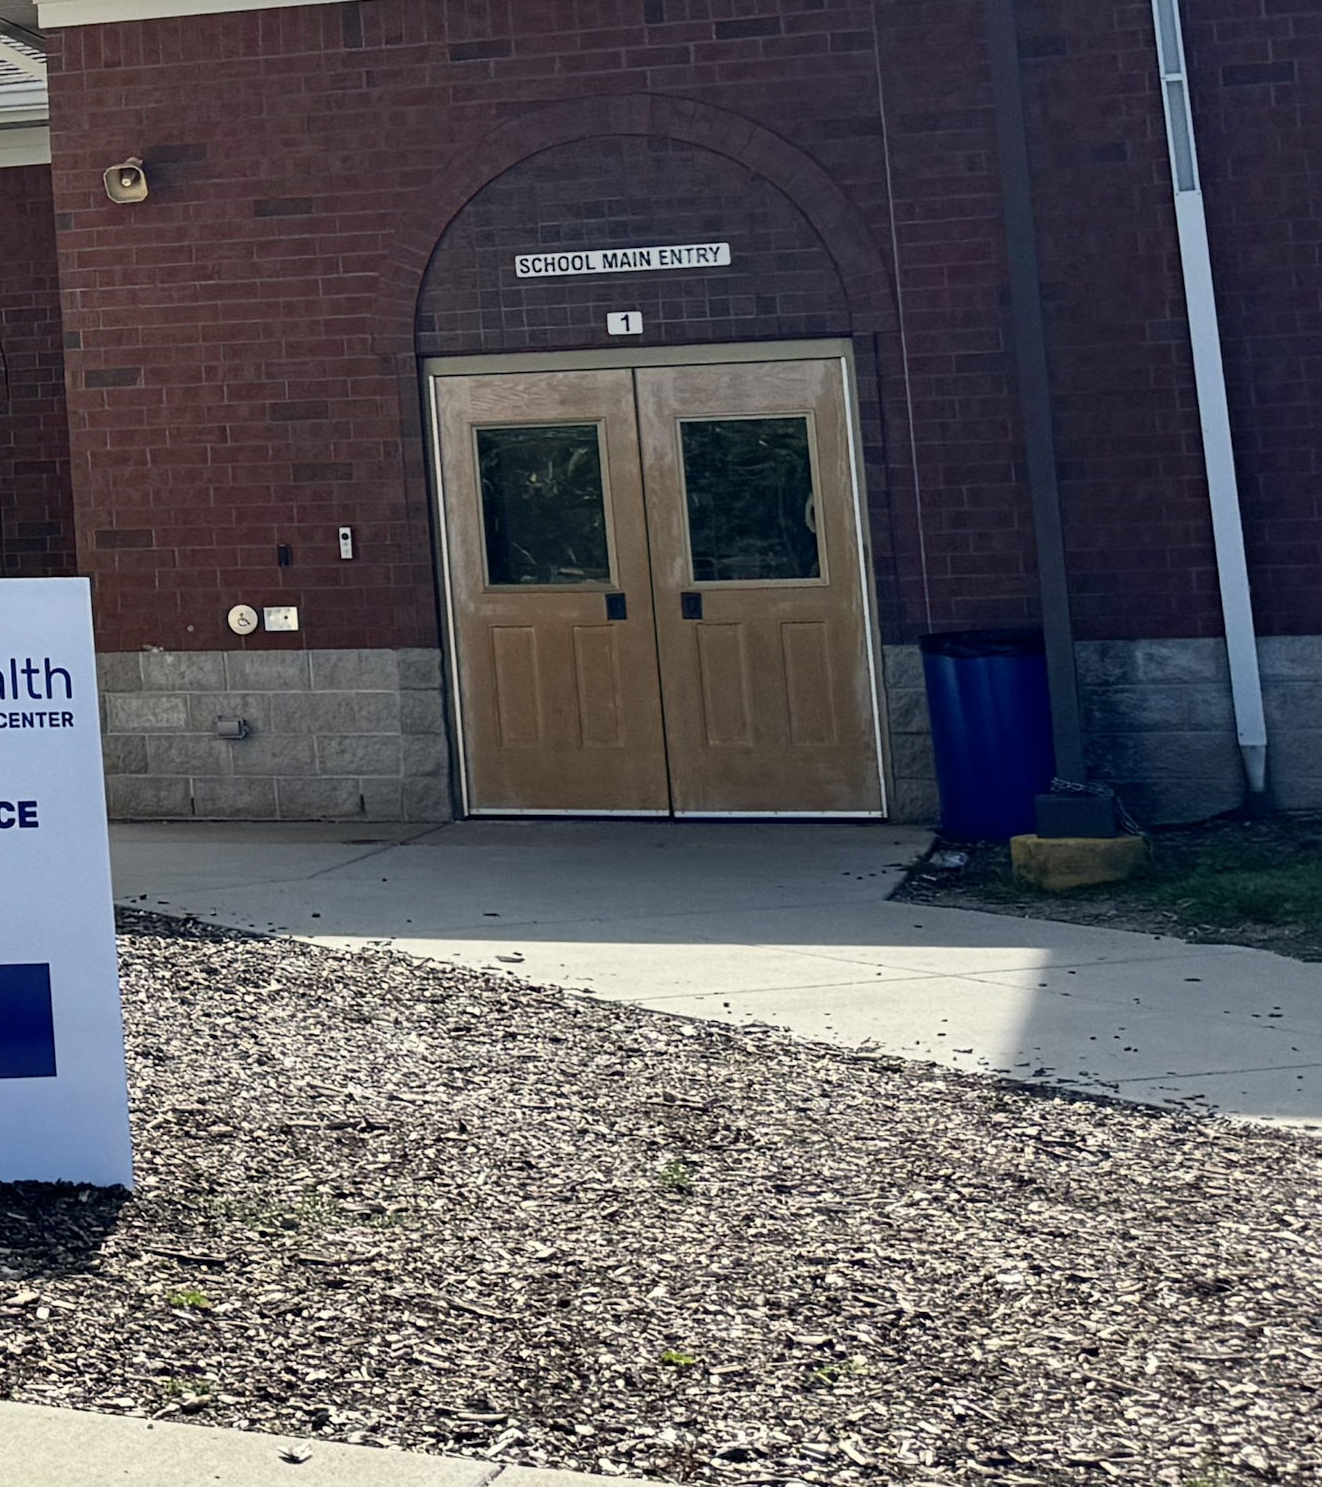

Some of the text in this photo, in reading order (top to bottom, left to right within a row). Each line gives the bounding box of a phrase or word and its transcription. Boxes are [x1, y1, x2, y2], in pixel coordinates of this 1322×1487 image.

[519, 246, 721, 274] SCHOOL MAIN ENTRY
[620, 314, 631, 332] 1
